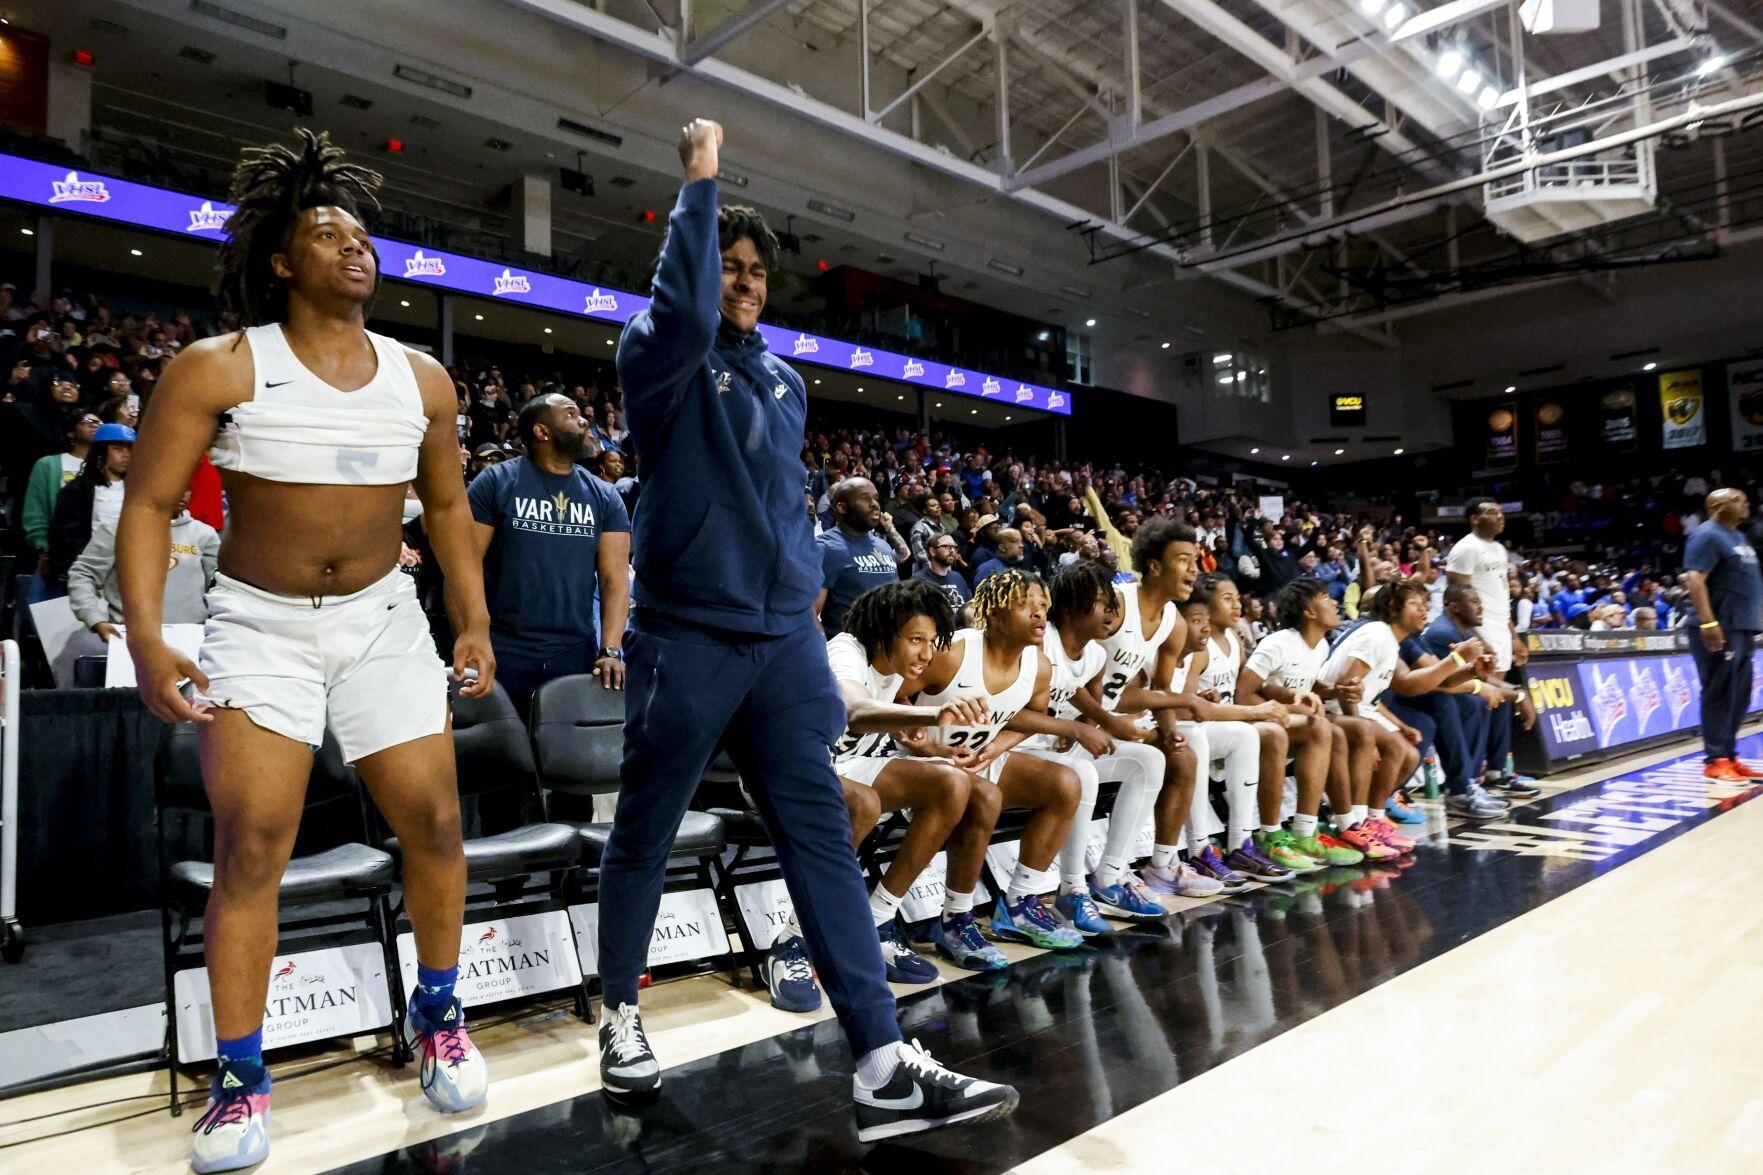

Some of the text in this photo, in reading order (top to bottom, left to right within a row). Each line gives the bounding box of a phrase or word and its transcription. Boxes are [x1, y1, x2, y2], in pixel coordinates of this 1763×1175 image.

[512, 519, 595, 536] BASKETBALL
[480, 945, 497, 954] THE
[457, 950, 550, 981] EATMAN
[274, 982, 295, 992] THE
[476, 977, 512, 989] GROUP
[266, 1017, 310, 1032] GROUP
